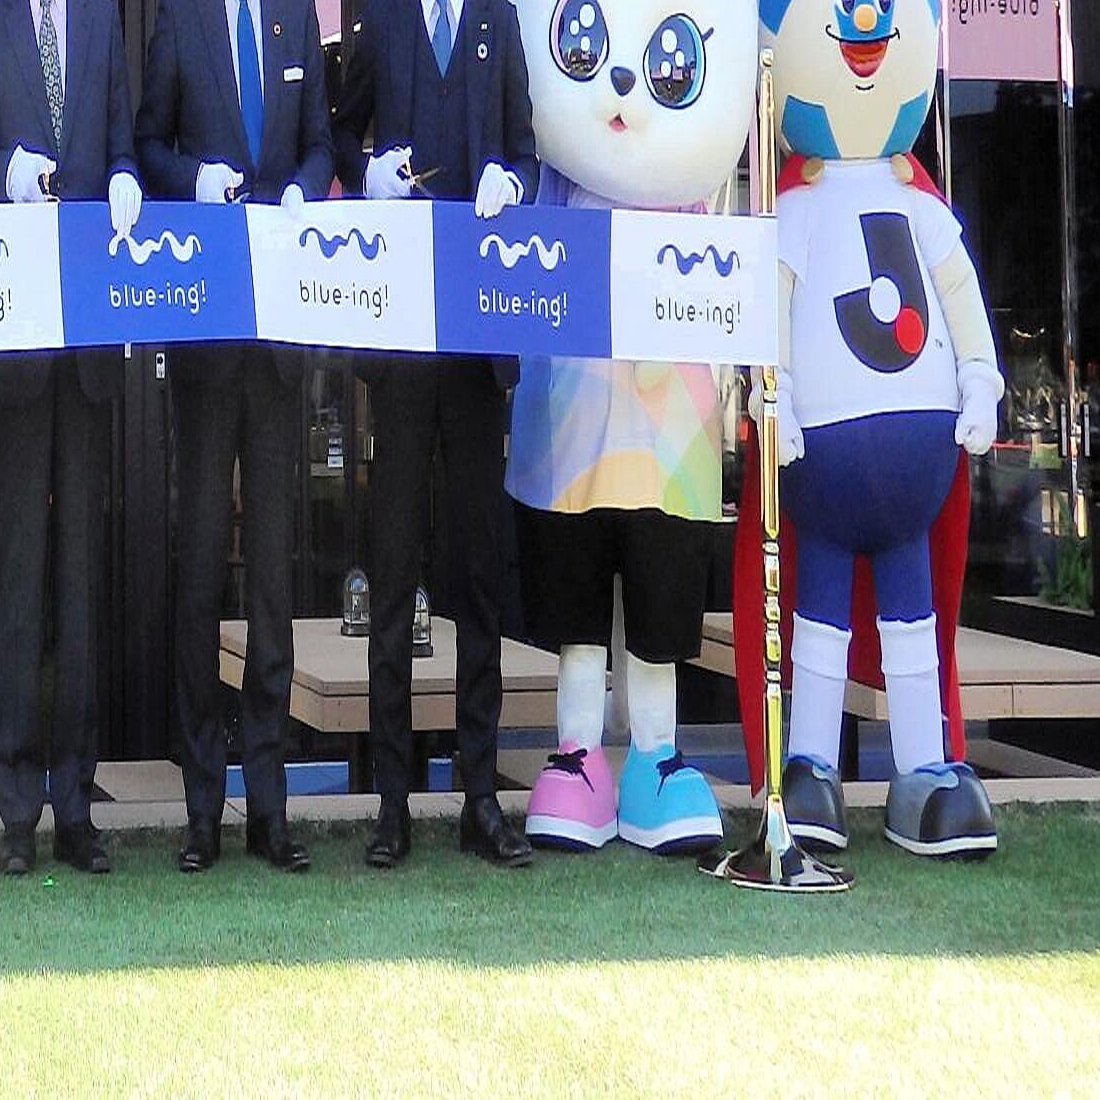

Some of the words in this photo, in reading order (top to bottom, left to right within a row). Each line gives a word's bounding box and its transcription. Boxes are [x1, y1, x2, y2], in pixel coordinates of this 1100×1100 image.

[109, 279, 208, 315] blue-ing!
[299, 279, 389, 319] blue-ing!
[478, 288, 568, 328] blue-ing!
[654, 296, 741, 335] blue-ing!
